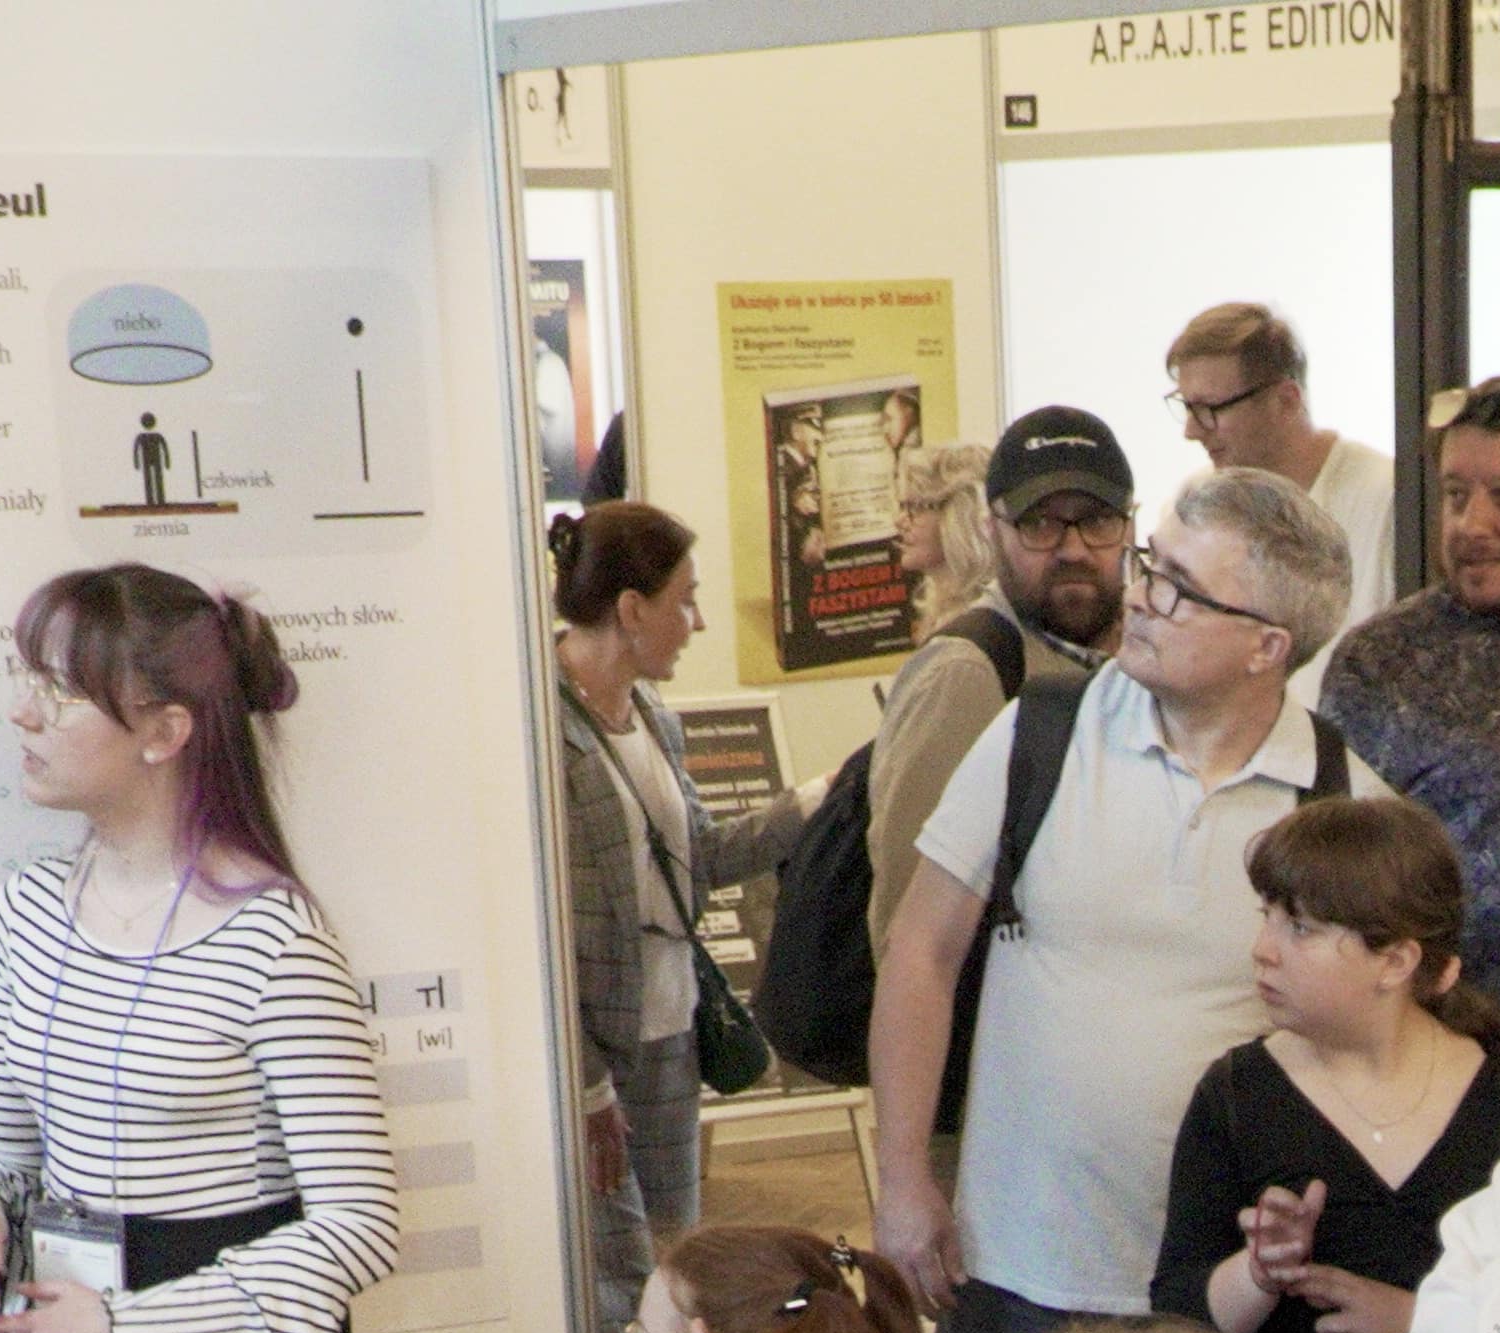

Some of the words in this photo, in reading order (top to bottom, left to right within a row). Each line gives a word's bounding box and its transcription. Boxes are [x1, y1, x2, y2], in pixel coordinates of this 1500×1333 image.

[112, 313, 163, 333] niebo
[201, 469, 276, 491] człowiek
[133, 520, 191, 539] ziemia
[352, 602, 404, 627] słów.
[417, 1026, 453, 1053] [wi]
